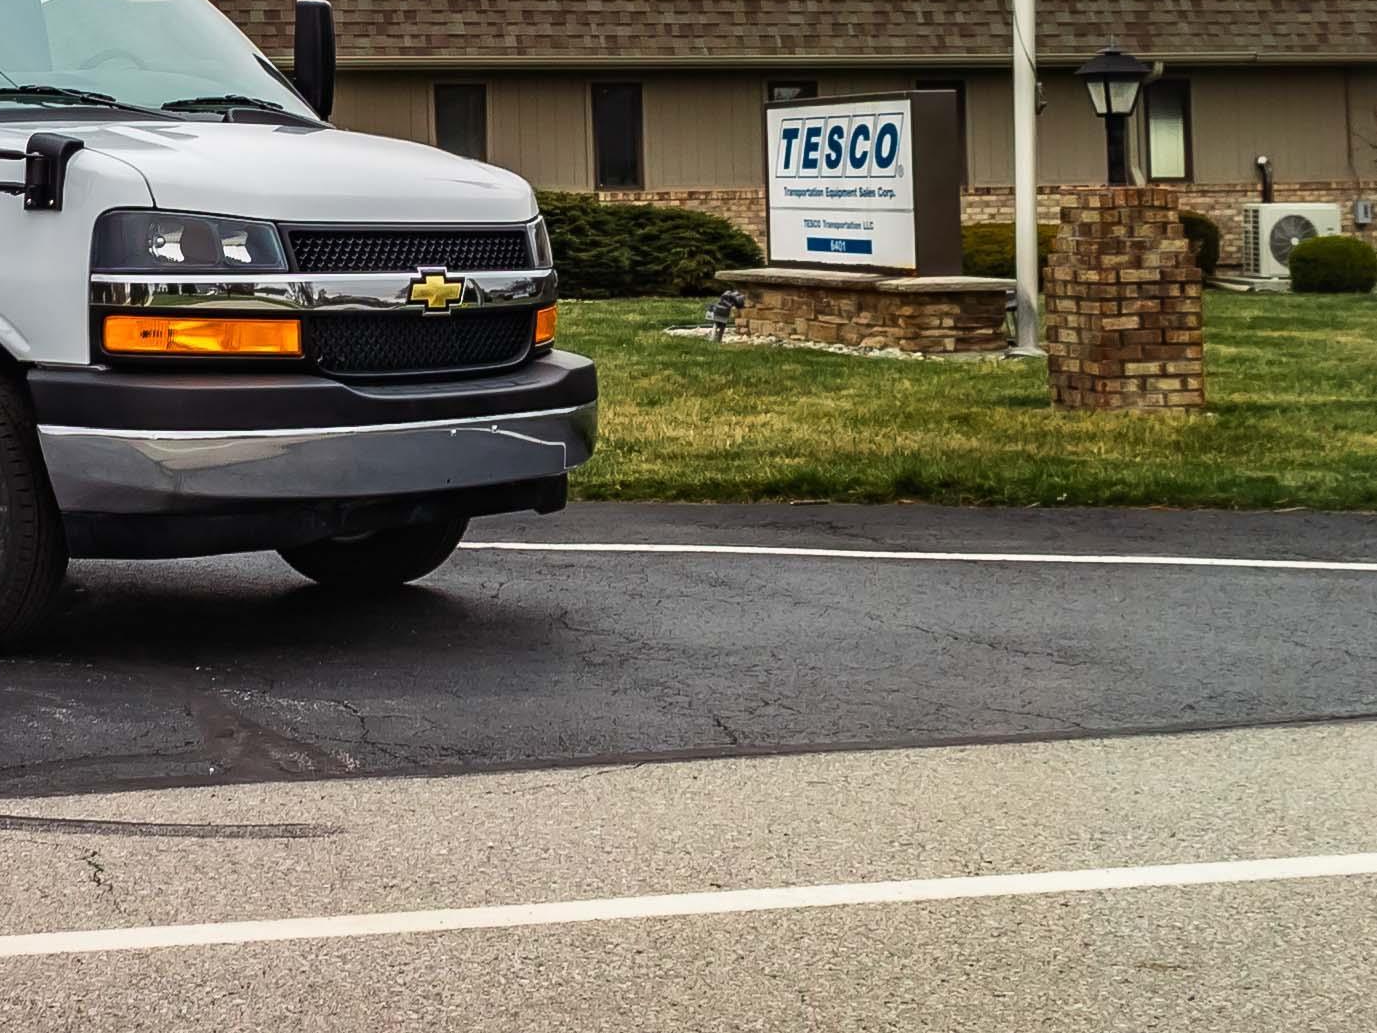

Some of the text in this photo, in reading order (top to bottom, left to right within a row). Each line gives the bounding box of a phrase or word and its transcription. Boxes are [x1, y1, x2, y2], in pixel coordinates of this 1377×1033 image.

[782, 122, 899, 170] TESCO
[784, 186, 896, 200] Transportation Equipment Sales Corp.
[803, 219, 821, 229] TESCO
[823, 219, 862, 231] Transportation
